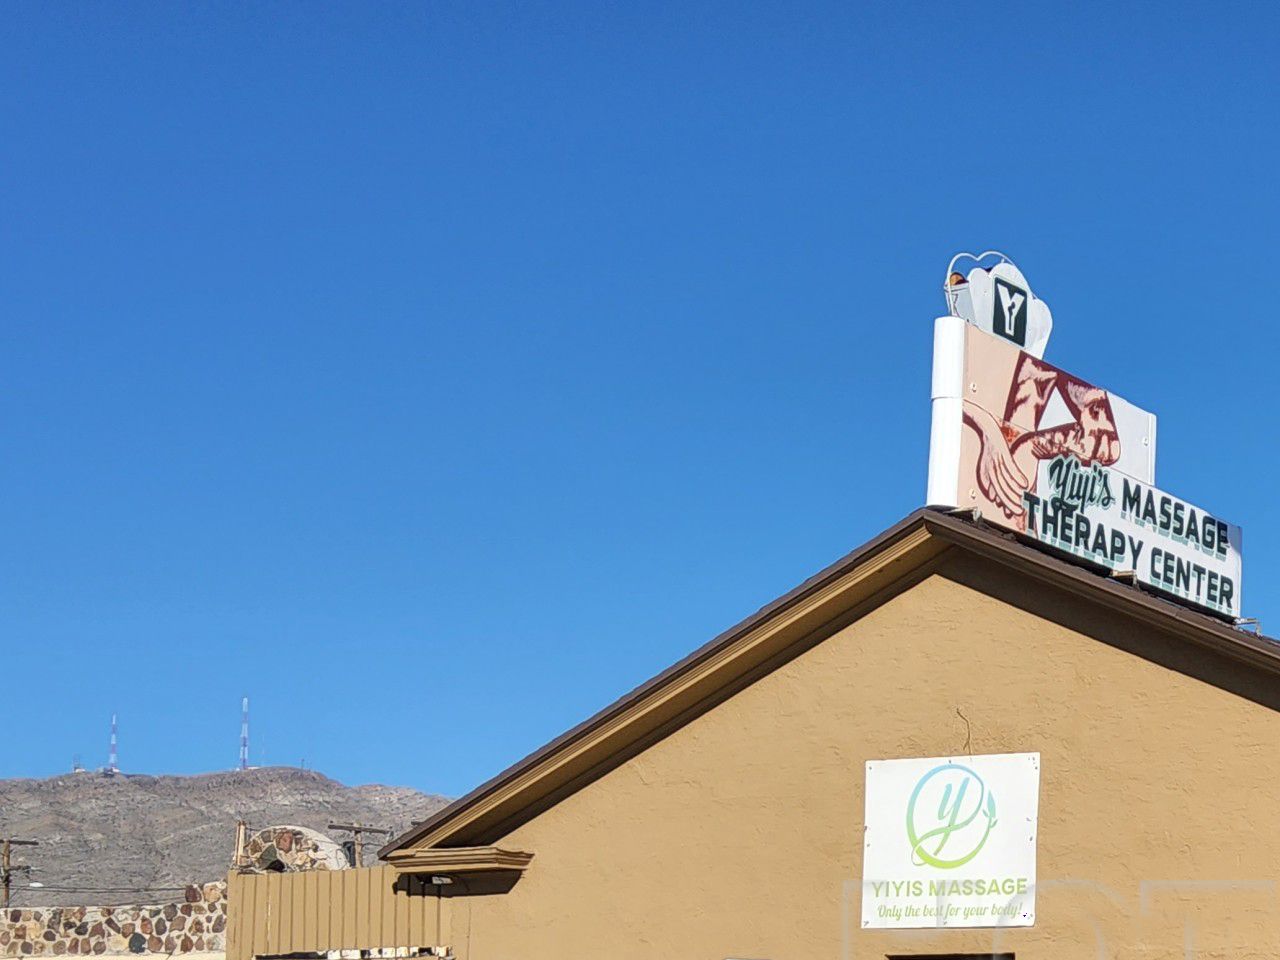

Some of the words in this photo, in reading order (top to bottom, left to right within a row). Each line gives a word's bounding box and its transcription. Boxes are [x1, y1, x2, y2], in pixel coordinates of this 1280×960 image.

[997, 283, 1025, 336] Y
[1049, 455, 1116, 514] Yiyi's
[1122, 477, 1231, 556] MASSAGE
[1023, 491, 1144, 570] THERAPY
[1150, 546, 1234, 609] CENTER
[872, 880, 923, 898] YIYIS
[929, 878, 1028, 896] MASSAGE
[877, 904, 902, 921] Only
[905, 904, 920, 918] the
[923, 904, 944, 917] best
[944, 903, 961, 919] for
[963, 907, 989, 920] your
[991, 902, 1023, 918] body!
